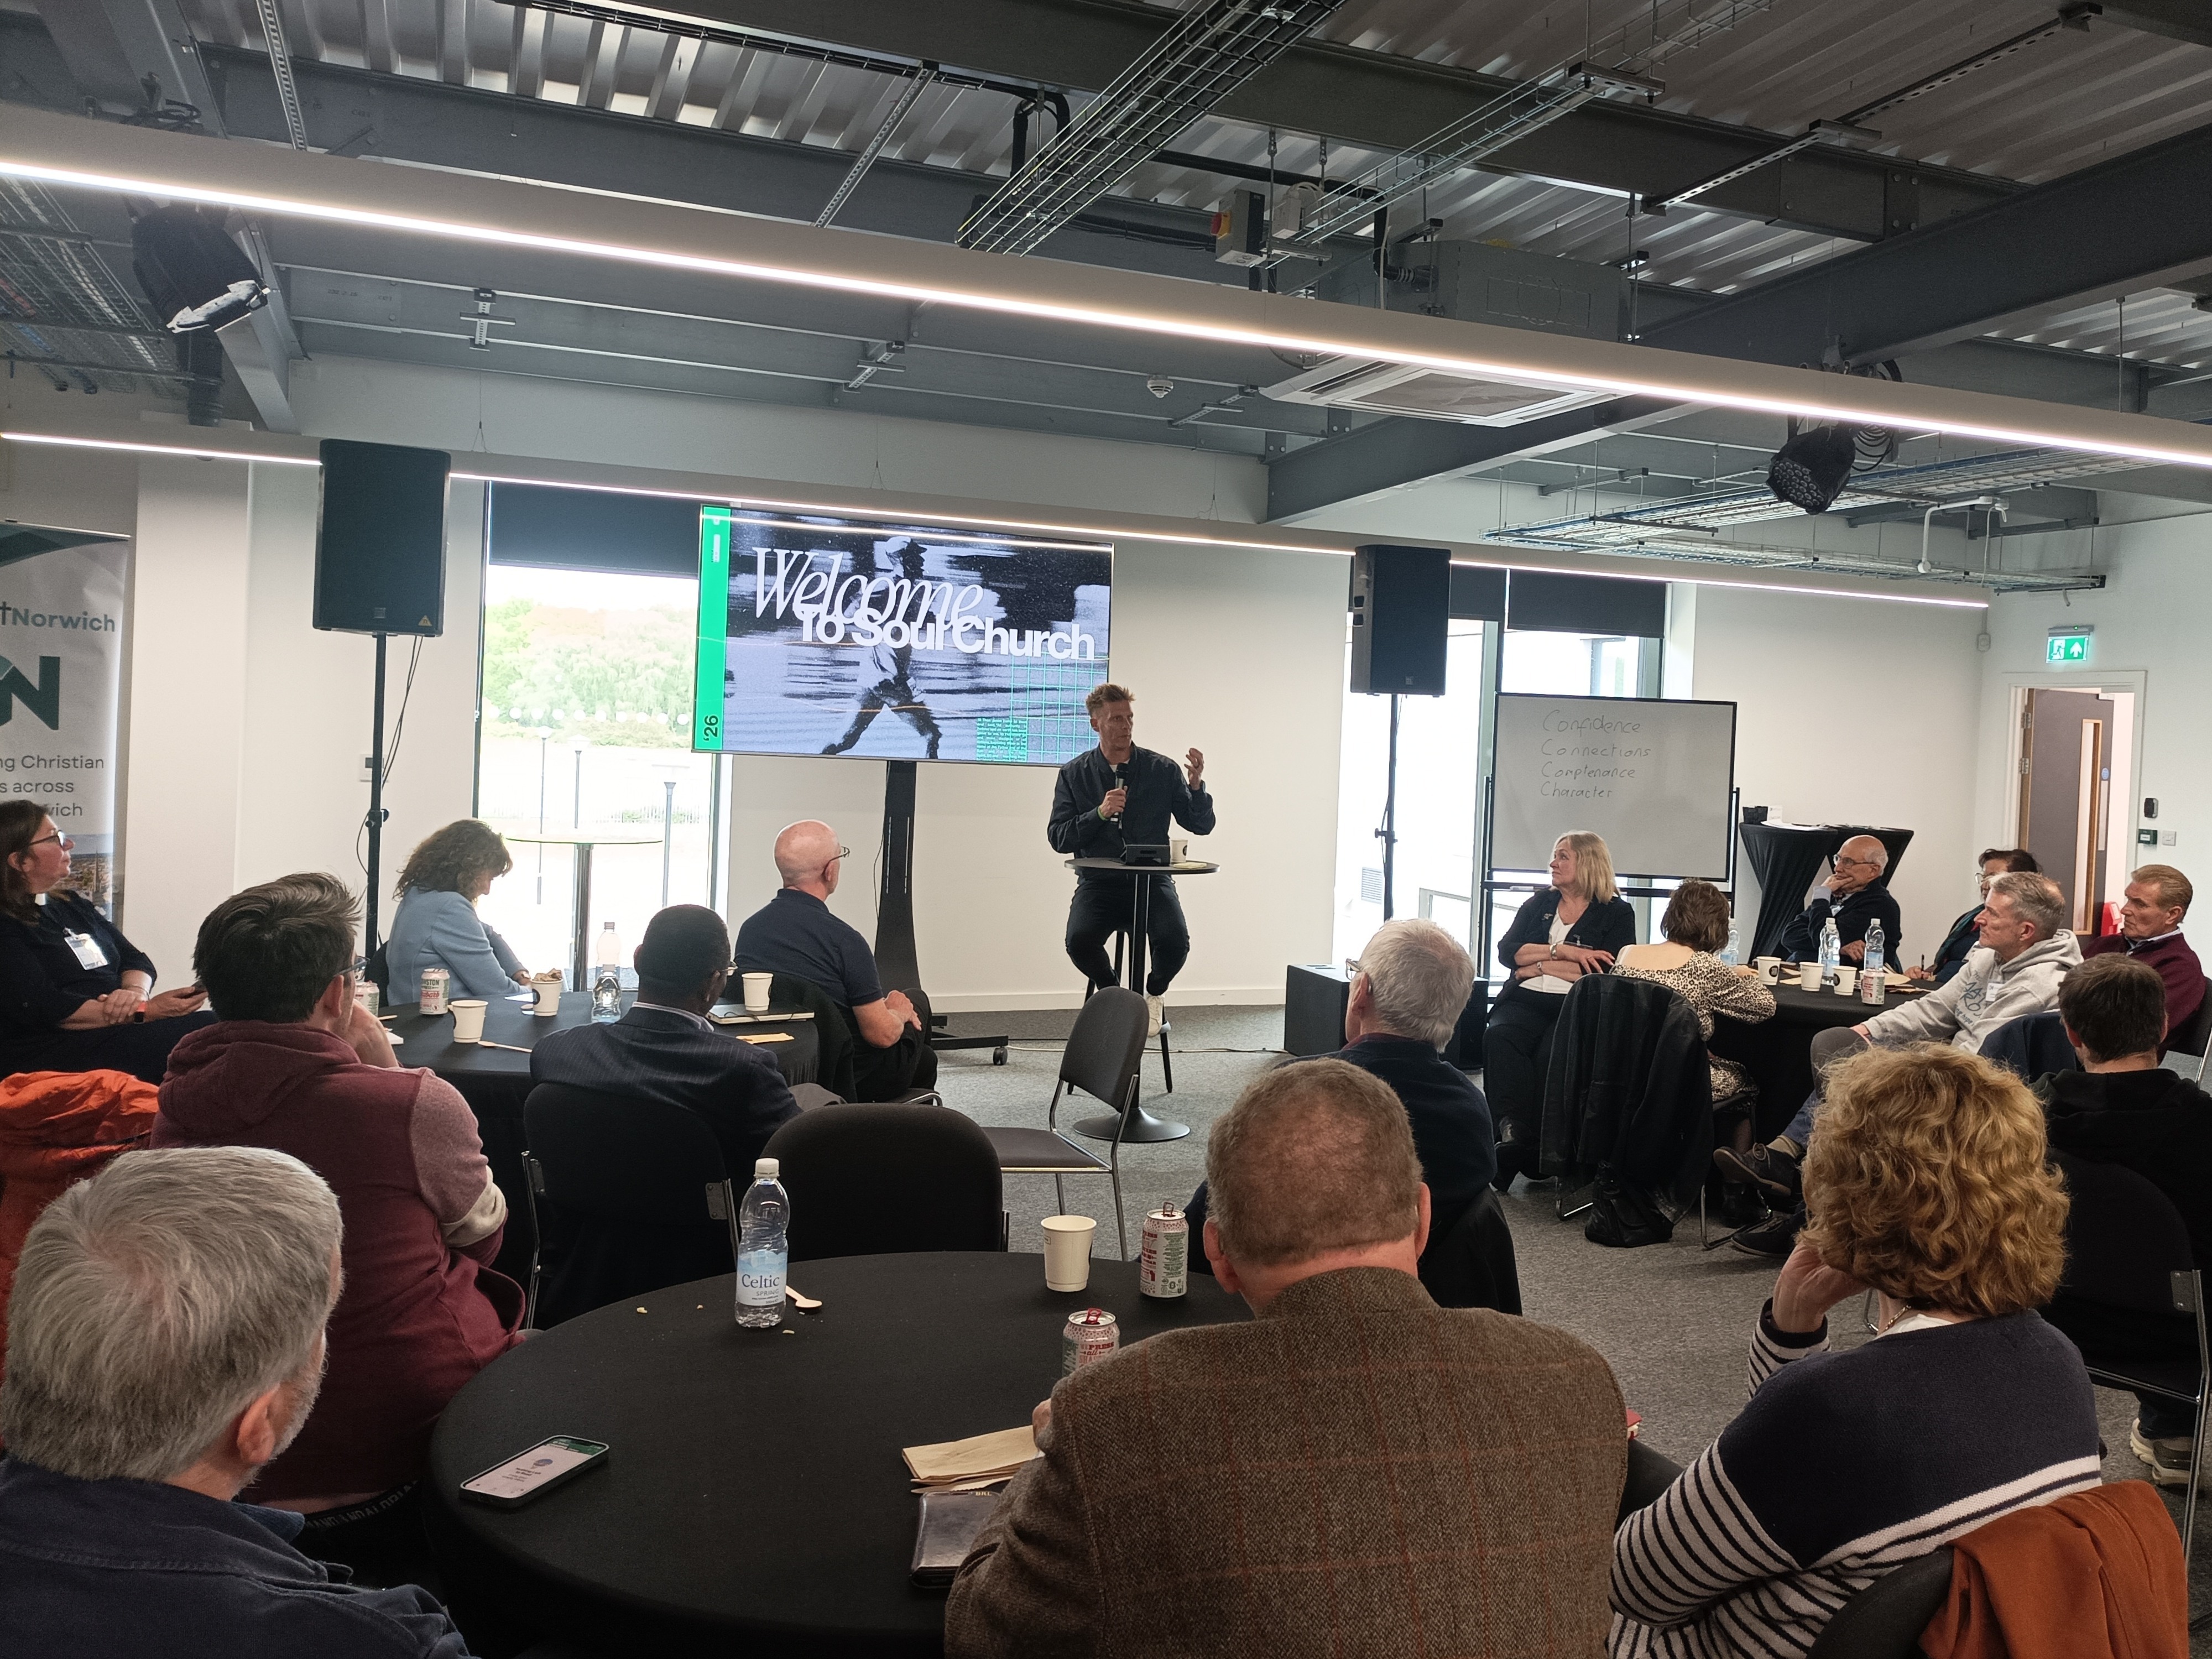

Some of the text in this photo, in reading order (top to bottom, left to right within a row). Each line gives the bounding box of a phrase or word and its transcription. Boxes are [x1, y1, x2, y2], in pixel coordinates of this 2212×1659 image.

[752, 547, 983, 631] Welcome
[792, 603, 1095, 660] To Soul Church
[1543, 709, 1641, 738] Confidence
[1541, 739, 1651, 757] Connections
[21, 755, 104, 769] Christian
[13, 782, 74, 792] across
[1541, 781, 1613, 799] Character
[742, 1274, 780, 1288] Celtic
[1089, 1342, 1114, 1350] PRESS
